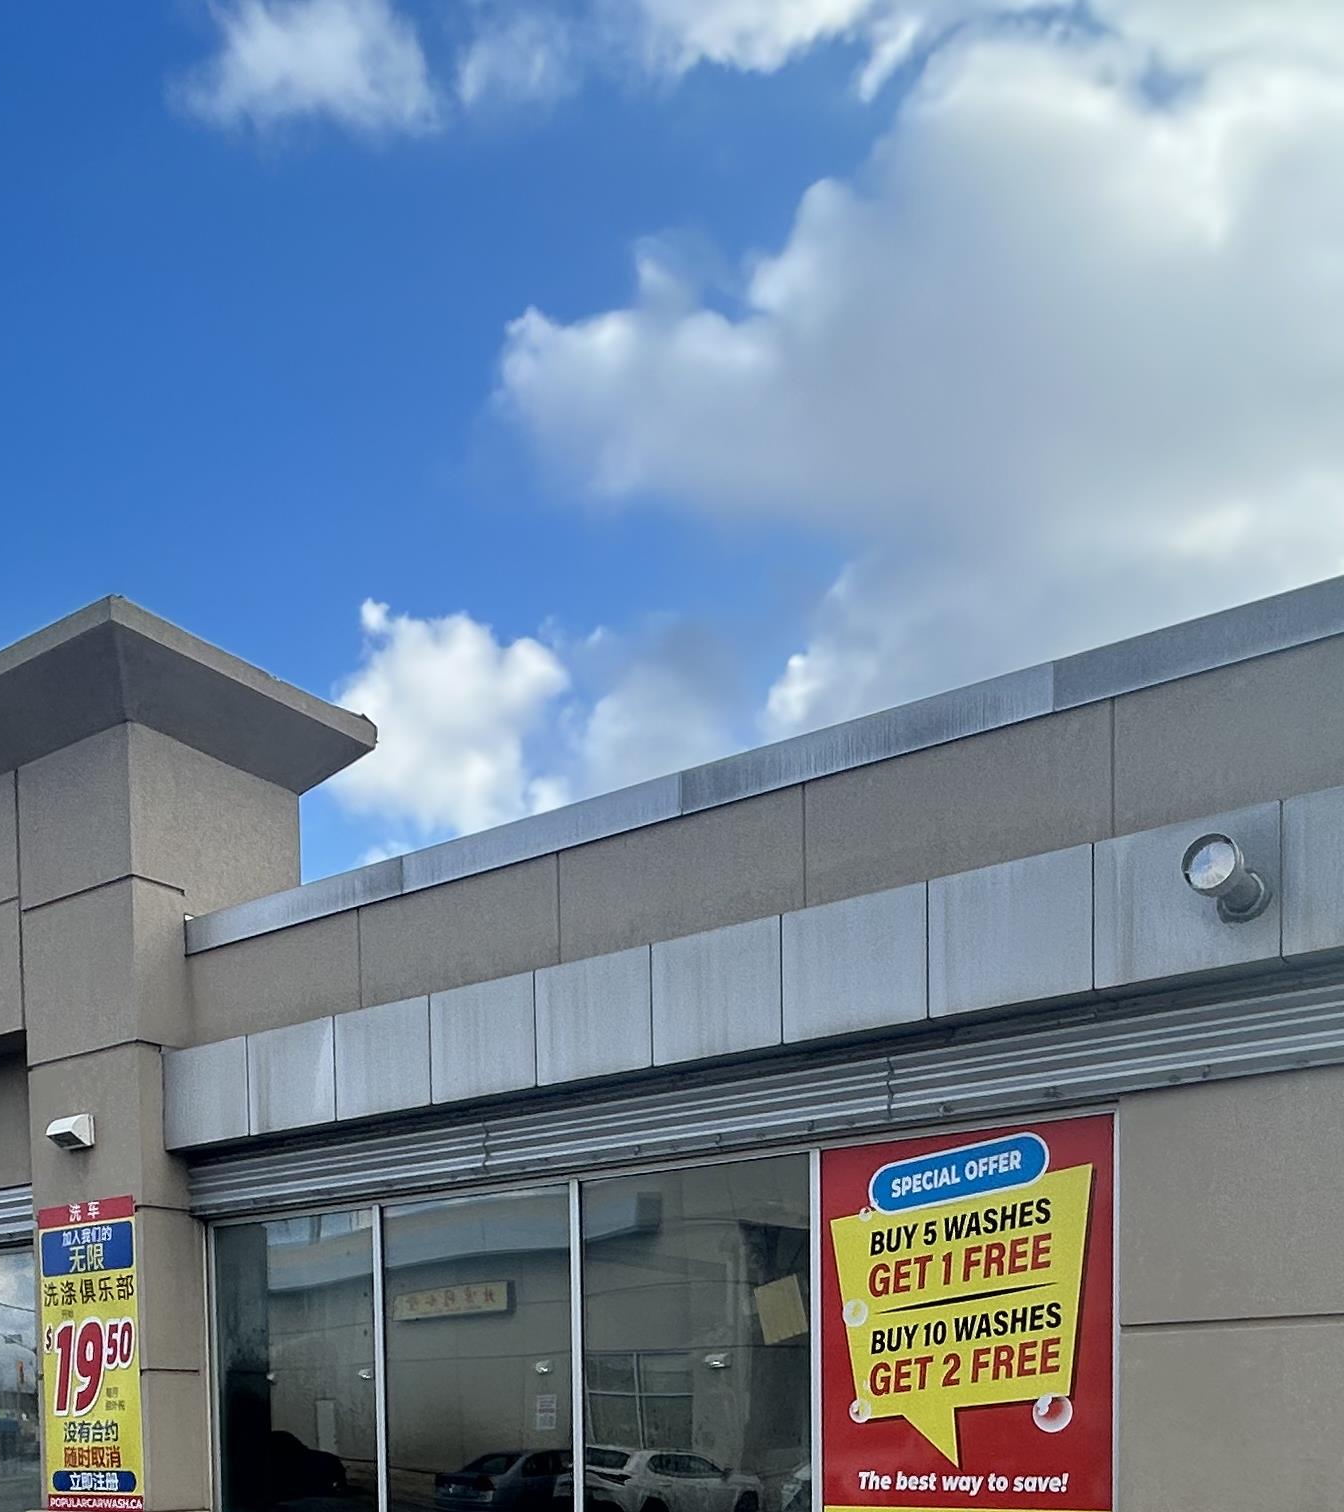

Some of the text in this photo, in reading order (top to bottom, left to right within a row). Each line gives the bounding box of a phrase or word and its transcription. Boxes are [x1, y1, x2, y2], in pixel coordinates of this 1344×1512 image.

[891, 1149, 1023, 1199] SPECIAL OFFER
[69, 1201, 101, 1222] 洗车
[62, 1226, 113, 1247] 加入我们的
[870, 1198, 1052, 1256] BUY 5 WASHES
[69, 1243, 105, 1273] 无限
[868, 1233, 1053, 1298] GET 1 FREE
[43, 1274, 135, 1308] 洗涤俱乐部
[870, 1302, 1062, 1355] BUY 10 WASHES
[868, 1337, 1062, 1397] GET 2 FREE
[63, 1420, 119, 1444] 没有合约
[63, 1446, 122, 1469] 随时取消
[69, 1472, 119, 1491] 立即注册
[858, 1471, 1069, 1496] The best way to save!
[49, 1497, 143, 1510] POPULARCARWASH.CA
